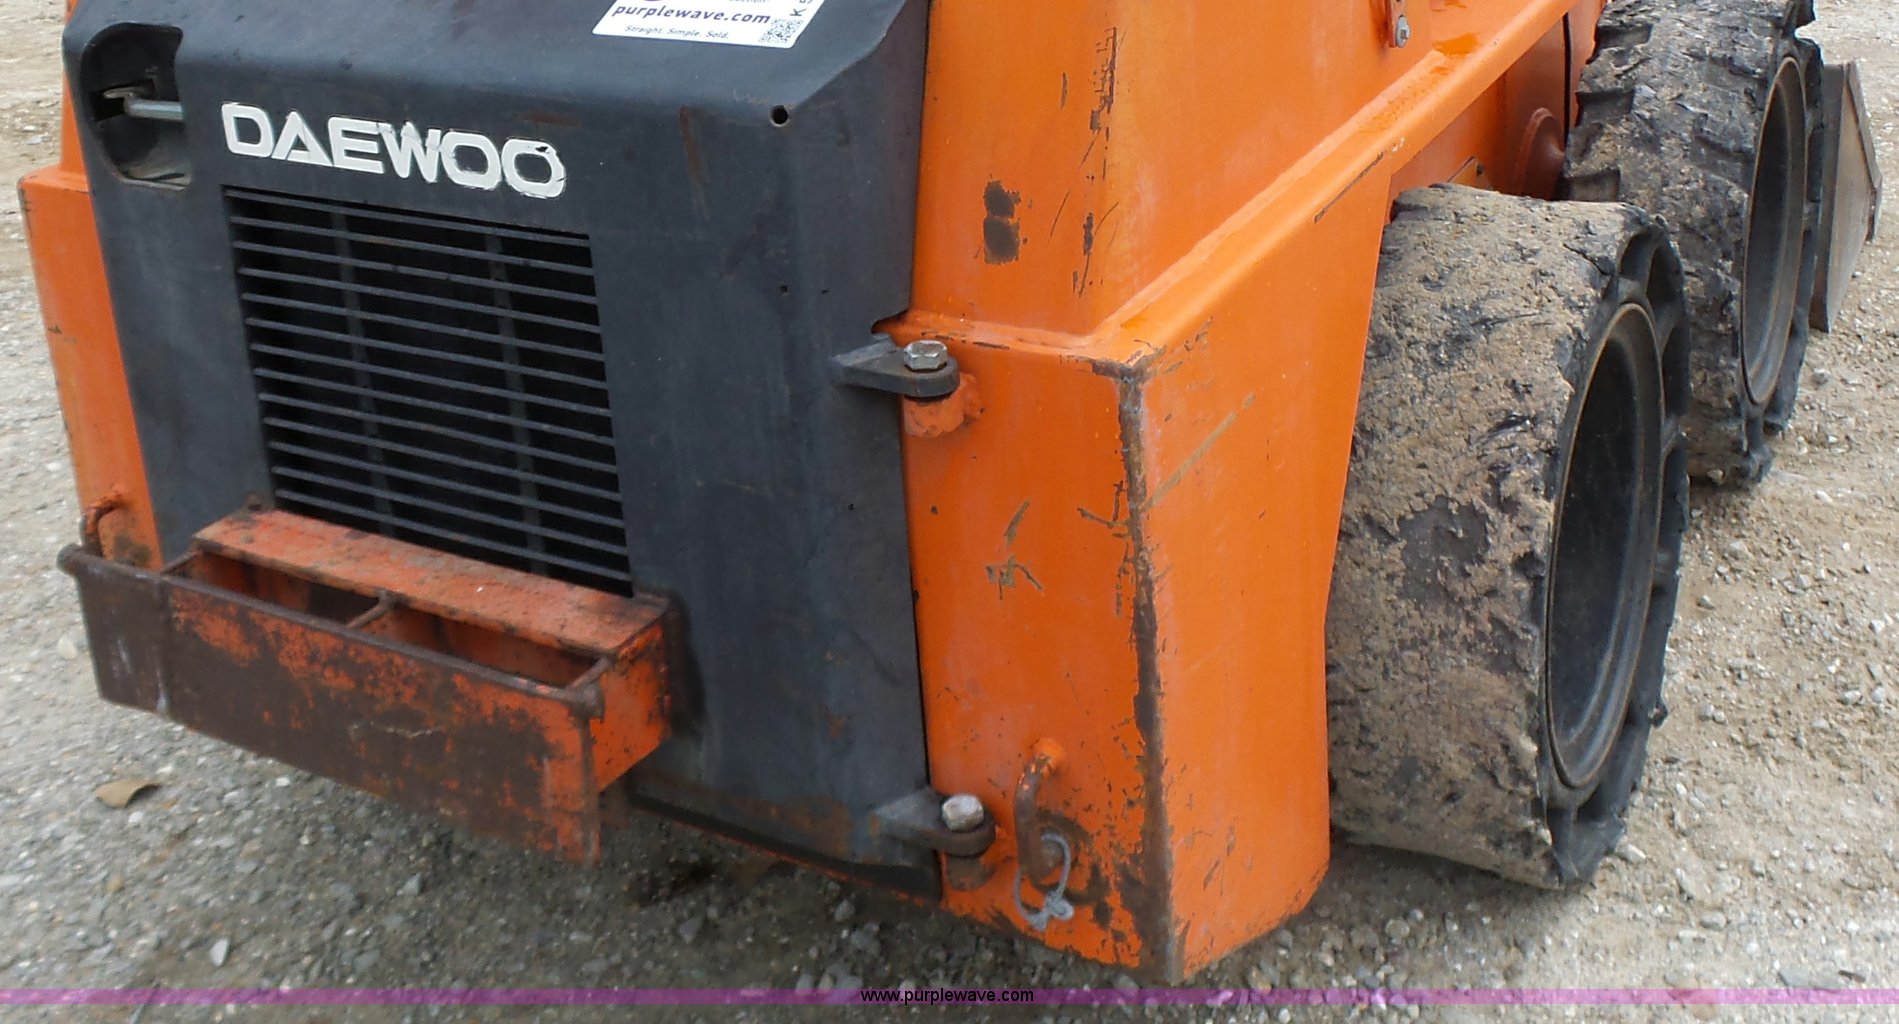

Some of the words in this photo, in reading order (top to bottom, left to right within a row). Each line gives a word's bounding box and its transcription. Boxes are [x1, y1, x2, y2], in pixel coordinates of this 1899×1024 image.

[611, 5, 771, 25] purplewave.com
[789, 8, 807, 17] K
[624, 24, 664, 36] Straight.
[666, 27, 701, 38] Simple.
[705, 30, 729, 39] Sold.
[220, 101, 567, 199] DAEWOO
